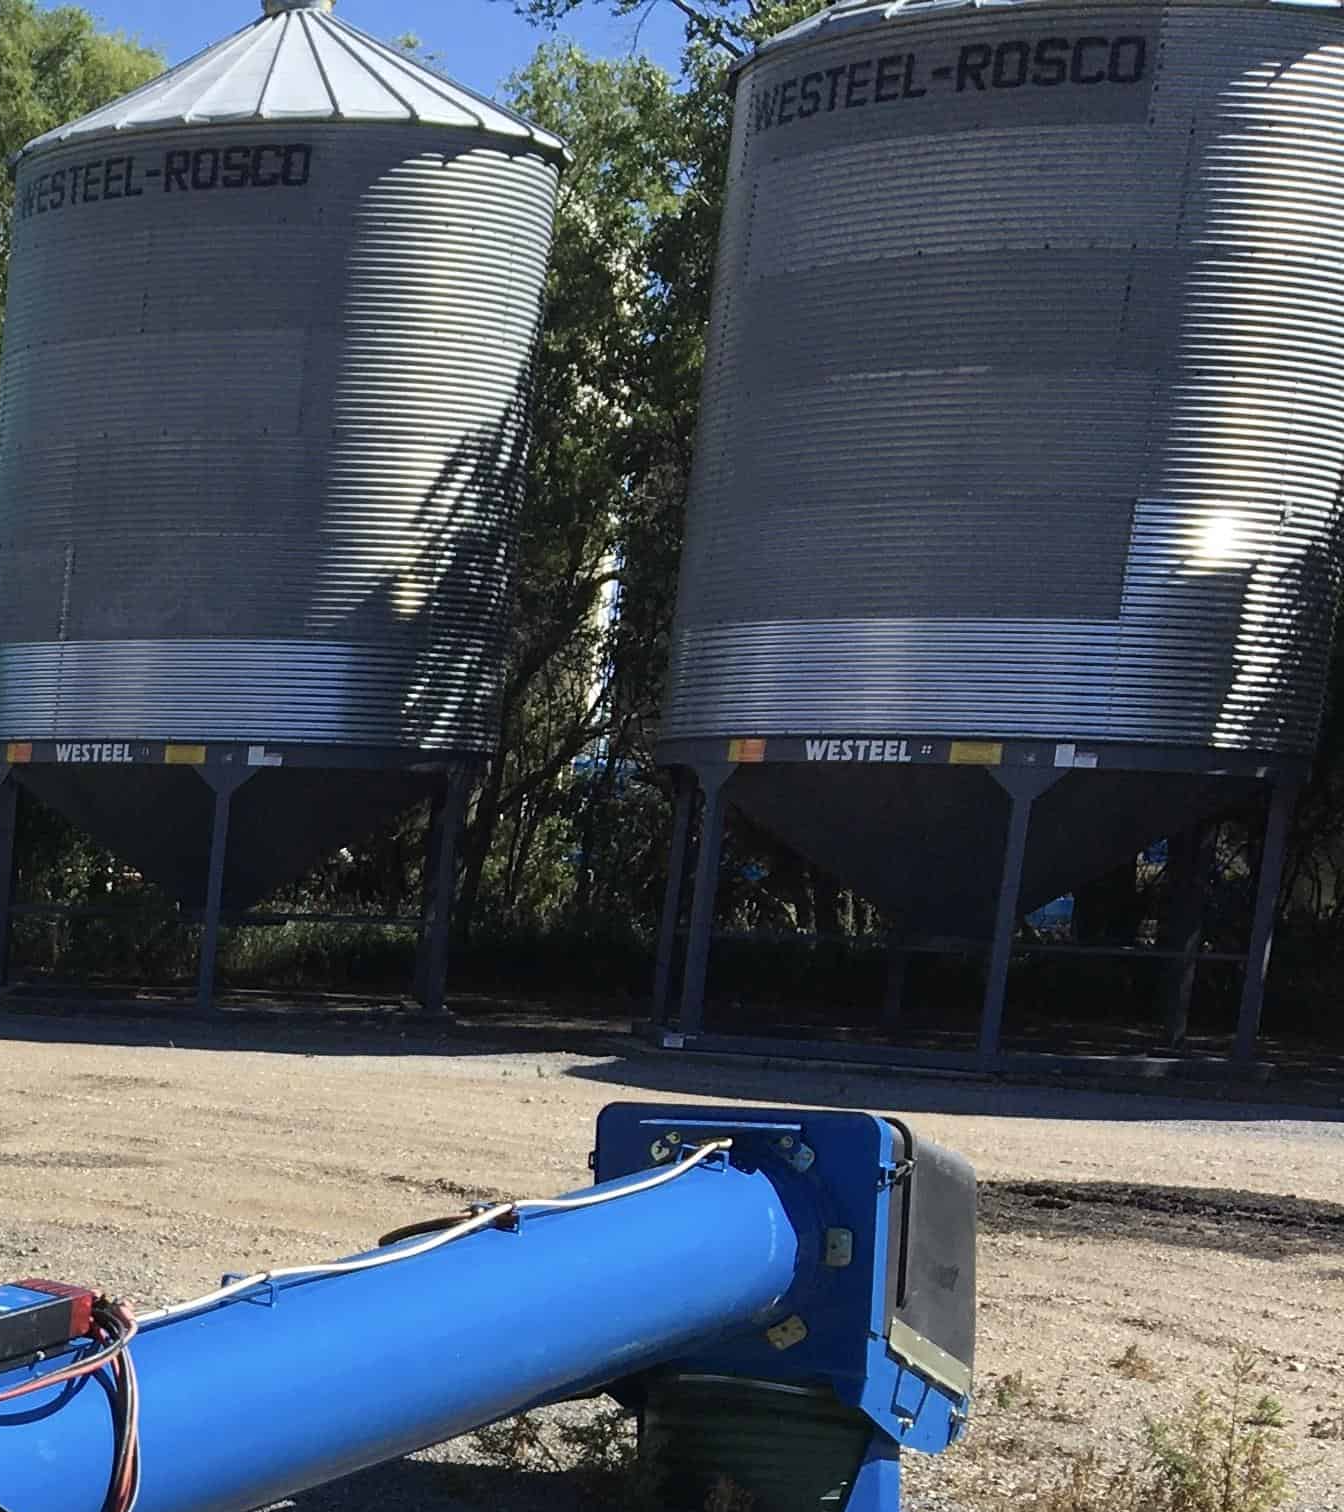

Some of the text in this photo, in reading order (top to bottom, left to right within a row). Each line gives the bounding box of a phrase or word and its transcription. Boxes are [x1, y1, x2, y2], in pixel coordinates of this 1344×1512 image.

[753, 34, 1148, 134] WESTEEL-ROSCO
[21, 143, 311, 219] WESTEEL-ROSCO
[56, 743, 134, 763] WESTEEL
[805, 739, 912, 761] WESTEEL
